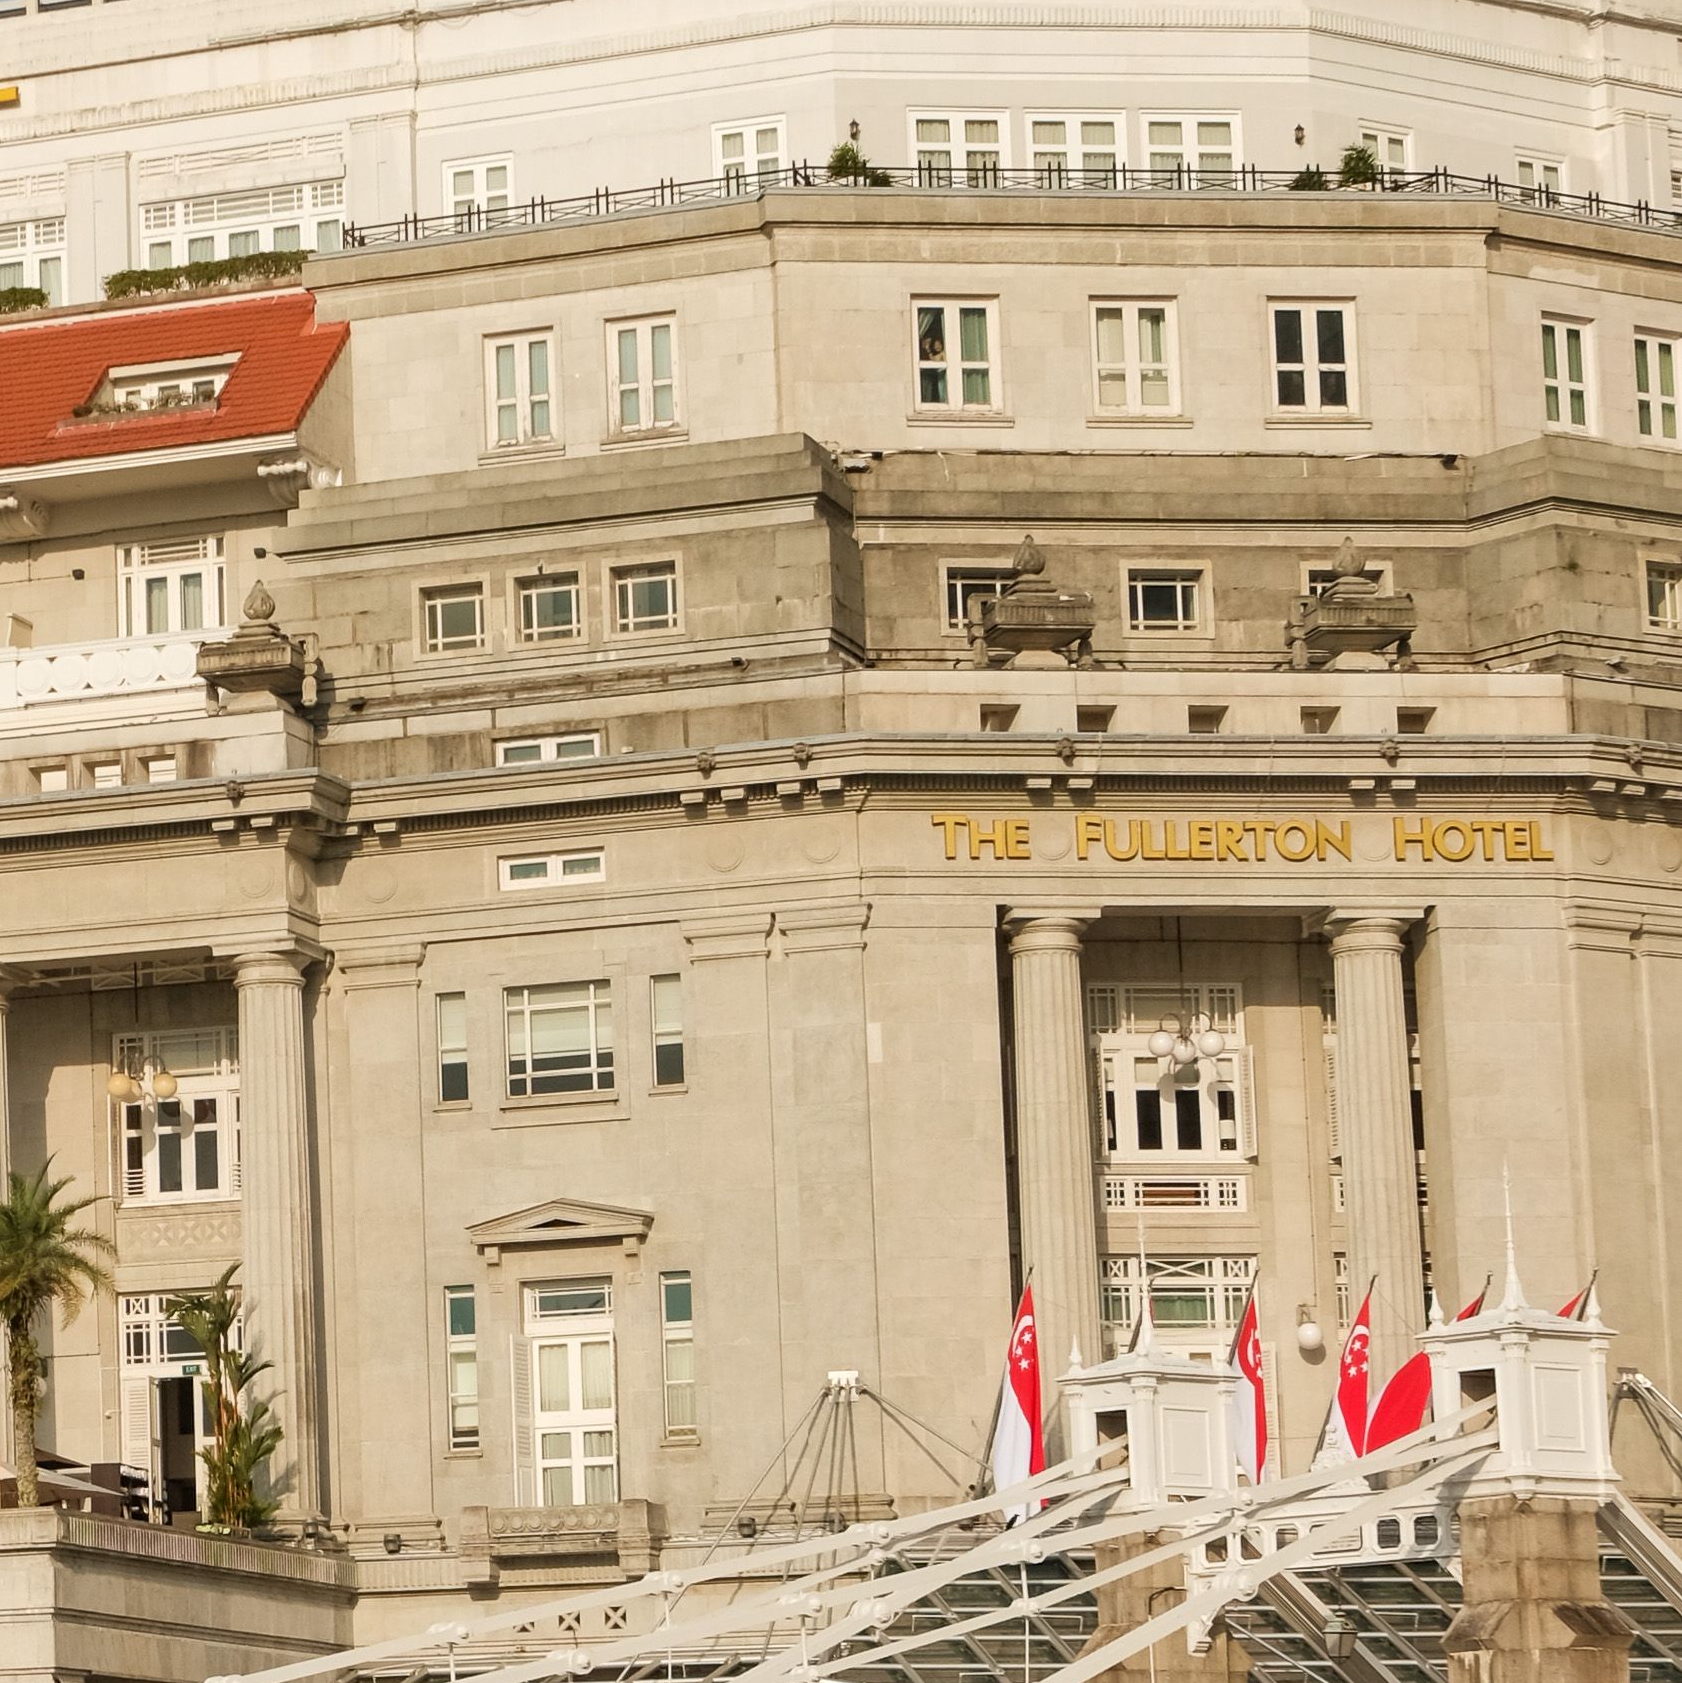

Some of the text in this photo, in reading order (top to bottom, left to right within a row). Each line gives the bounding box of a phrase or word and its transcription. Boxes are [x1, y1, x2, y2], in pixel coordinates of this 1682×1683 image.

[931, 815, 1555, 862] THE FULLERTON HOTEL
